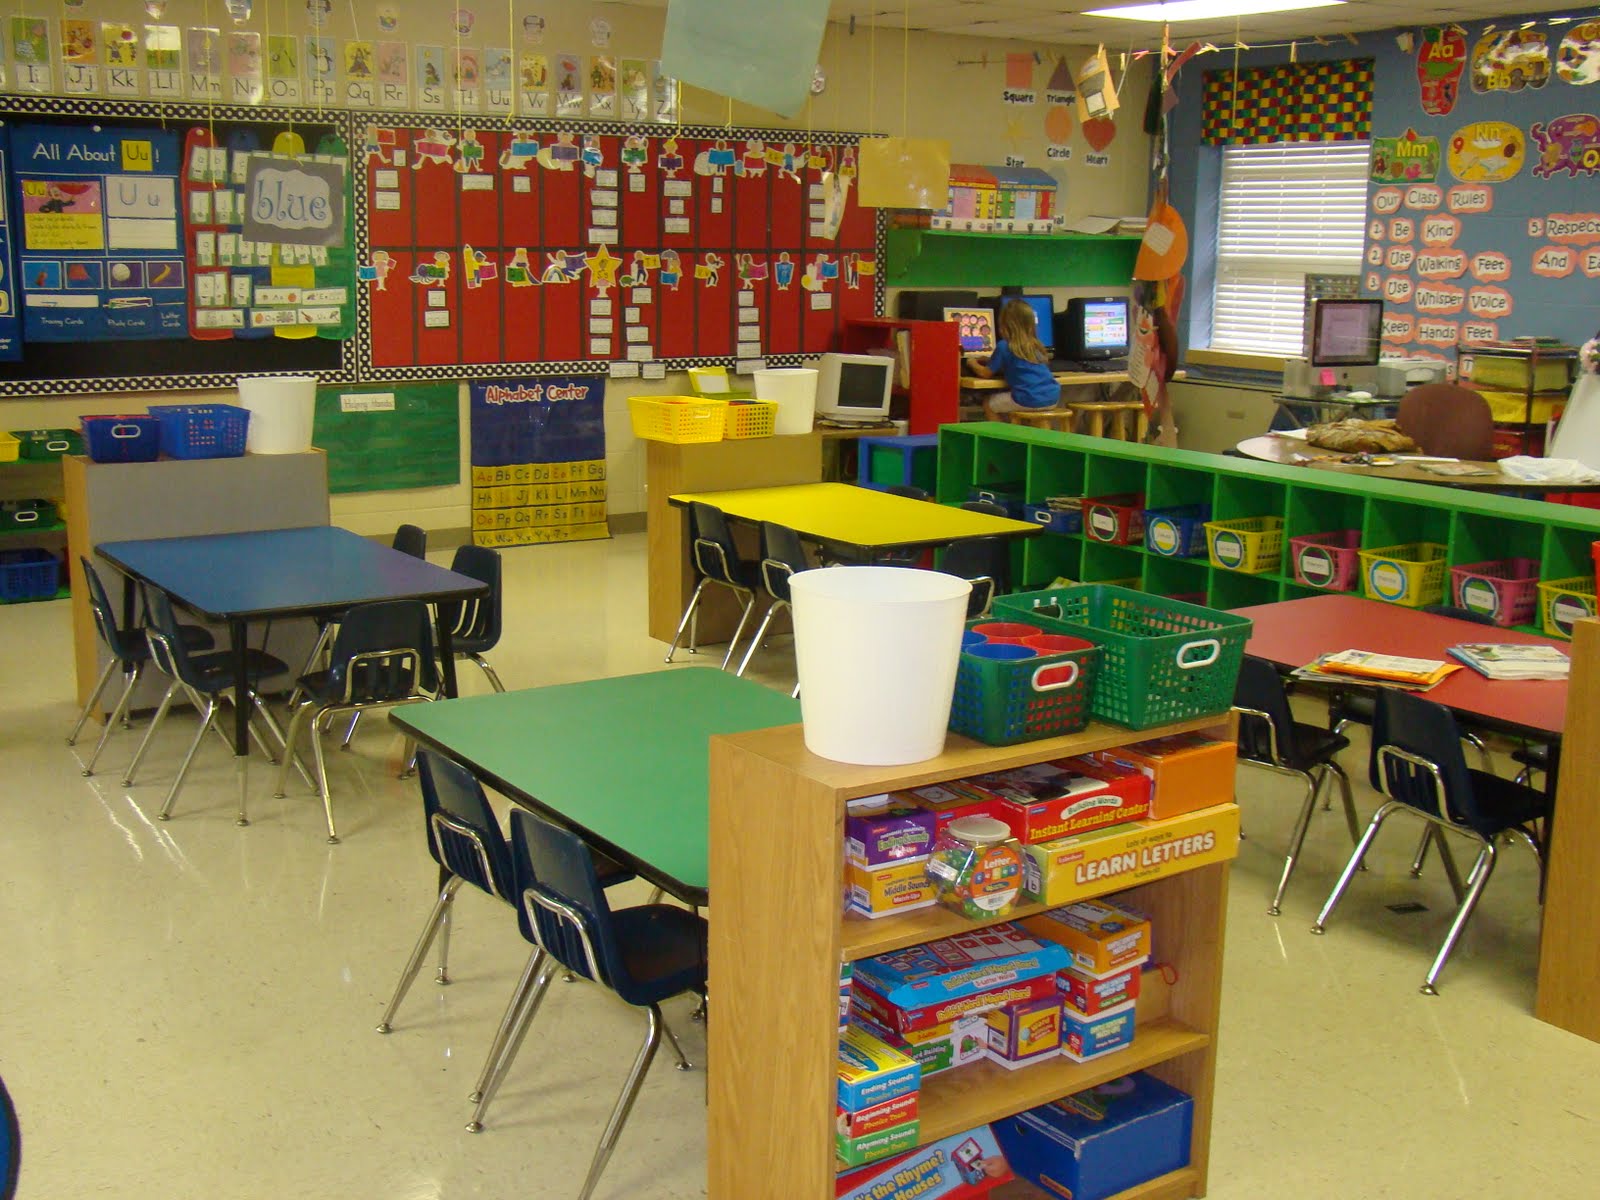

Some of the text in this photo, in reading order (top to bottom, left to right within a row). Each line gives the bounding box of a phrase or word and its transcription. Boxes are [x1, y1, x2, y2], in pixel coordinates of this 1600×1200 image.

[1428, 43, 1454, 59] Aa
[69, 65, 94, 92] Jj
[111, 69, 135, 88] Kk
[191, 75, 221, 92] Mm
[1487, 75, 1512, 90] Bb
[272, 80, 297, 97] Oo
[313, 79, 334, 102] Pp
[347, 83, 375, 106] Qq
[384, 84, 403, 100] Rr
[423, 87, 441, 104] Ss
[456, 89, 473, 105] Tt
[490, 90, 510, 106] Uu
[527, 93, 544, 108] Vv
[1003, 91, 1034, 104] Square
[1047, 94, 1076, 106] Triangle
[628, 98, 641, 119] Yy
[1475, 126, 1500, 141] Nn
[32, 142, 60, 160] All
[66, 143, 116, 162] About
[126, 143, 148, 160] Uu
[1047, 147, 1071, 158] Circle
[1397, 142, 1428, 157] Mm
[1006, 156, 1024, 168] Star
[1086, 154, 1108, 165] Heart
[256, 179, 327, 222] blue
[1377, 191, 1486, 210] Our Class Rules
[1394, 223, 1410, 236] Be
[1426, 224, 1454, 238] Kind
[1390, 251, 1411, 266] Use
[1417, 257, 1462, 272] Walking
[1478, 257, 1506, 272] Feet
[1538, 253, 1568, 268] And
[1388, 281, 1409, 296] Use
[1417, 291, 1463, 306] Whisper
[1471, 294, 1506, 310] Voice
[1383, 321, 1493, 339] Keep Hands Feet
[486, 383, 589, 405] Alphabet Center
[1067, 797, 1119, 815] Building Words
[1029, 803, 1149, 840] Instant Learning Center
[984, 857, 1012, 869] Letter
[1075, 832, 1215, 885] LEARN LETTERS
[884, 883, 907, 897] Middle
[861, 1073, 914, 1095] Ending Sounds
[855, 1097, 916, 1122] Beginning Sounds
[856, 1128, 916, 1151] Rhyming Sounds
[871, 1179, 896, 1197] the
[893, 1150, 945, 1187] Rhyme?
[894, 1171, 943, 1200] Houses
